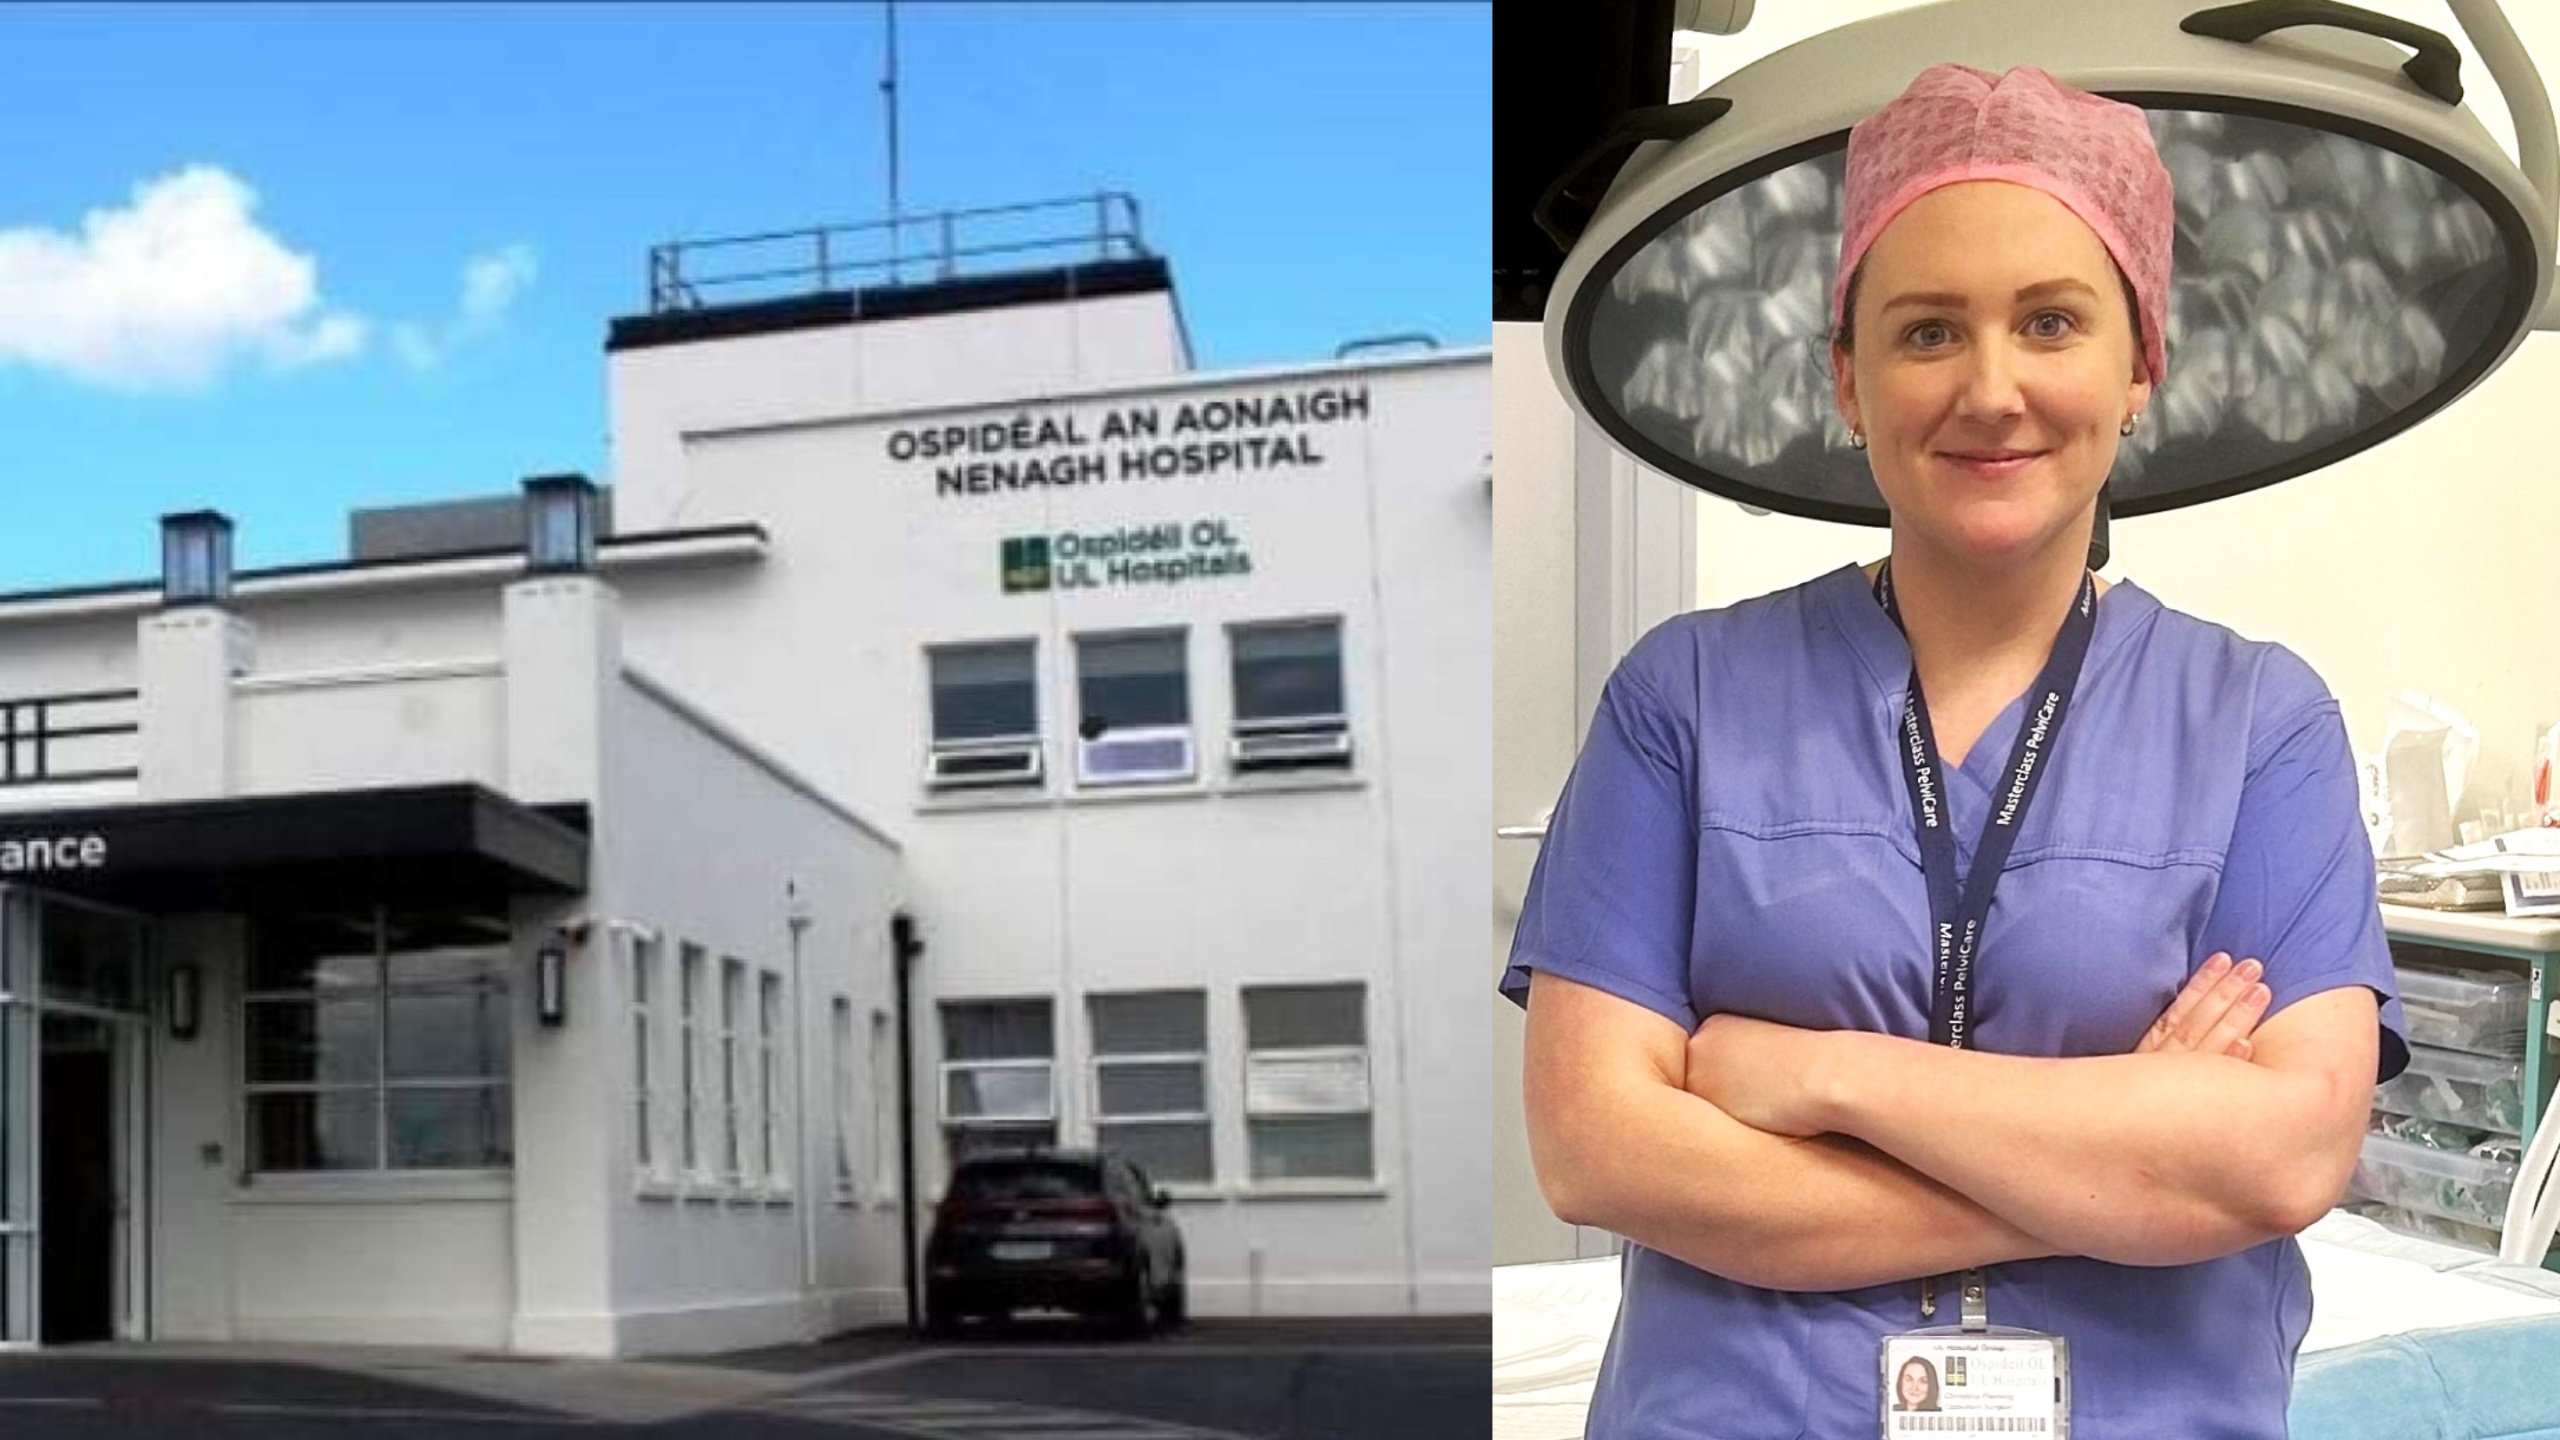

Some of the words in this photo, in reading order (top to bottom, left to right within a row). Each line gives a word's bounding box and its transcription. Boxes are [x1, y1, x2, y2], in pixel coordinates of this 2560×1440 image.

[887, 414, 1087, 461] OSPIDÉAL
[1101, 407, 1159, 441] AN
[1172, 387, 1369, 433] AONAIGH
[935, 453, 1107, 496] NENAGH
[1119, 436, 1324, 480] HOSPITAL
[1190, 520, 1240, 547] OL
[1056, 562, 1099, 589] UL
[1106, 552, 1251, 584] Hospitals
[1996, 751, 2038, 826] Masterclass
[2026, 691, 2060, 750] PelviCare
[1916, 766, 1938, 828] PelviCare
[1953, 919, 1977, 991] PelviCare
